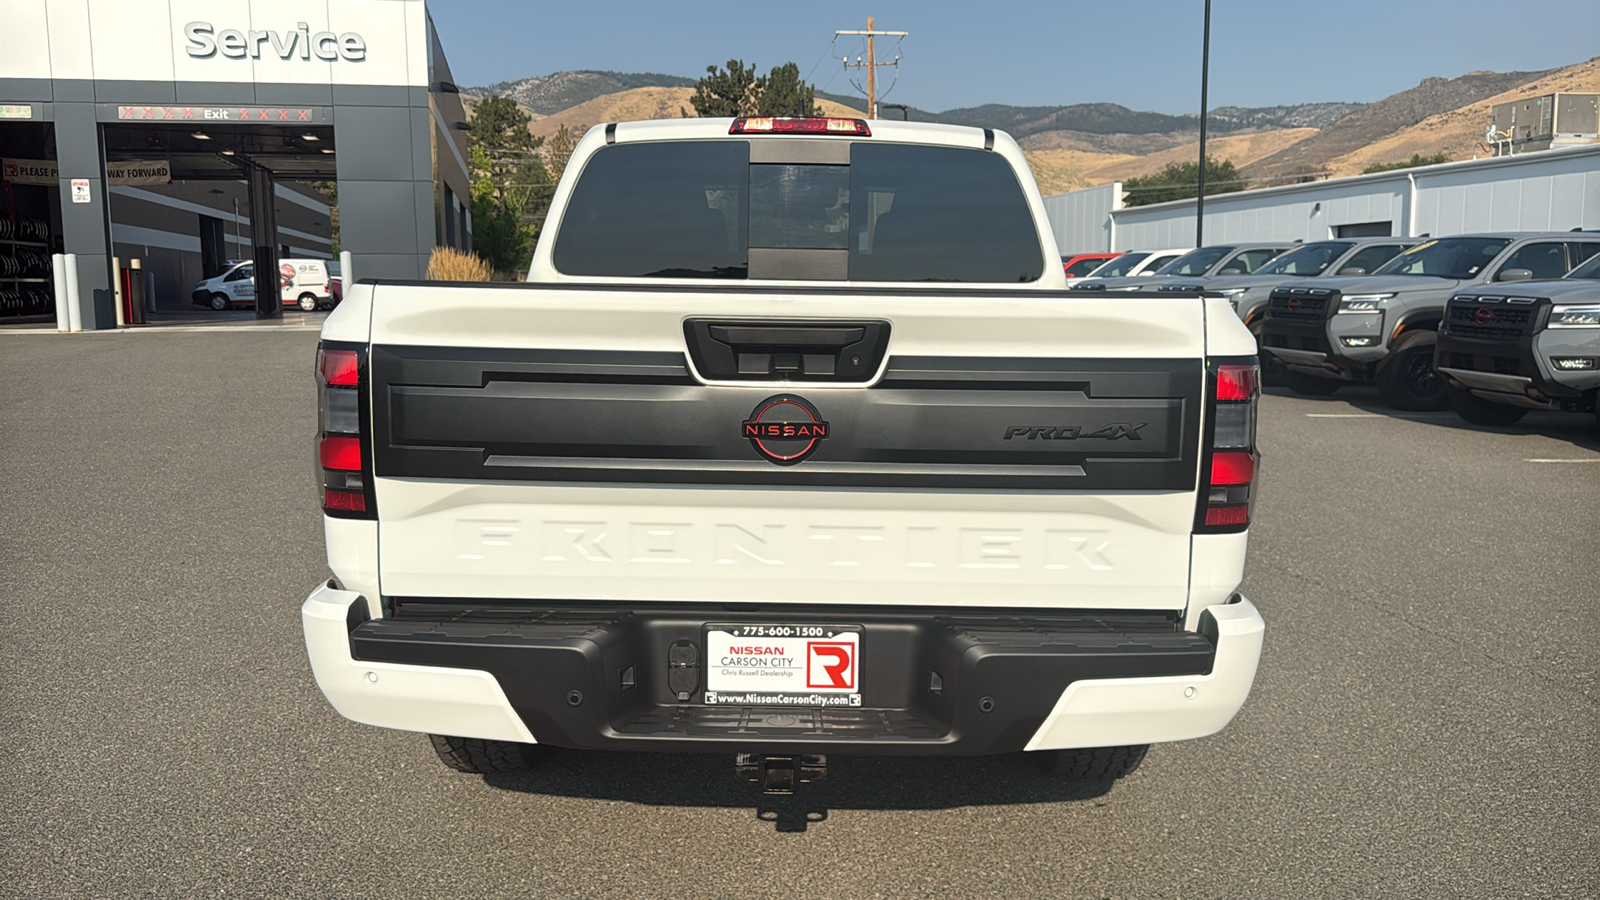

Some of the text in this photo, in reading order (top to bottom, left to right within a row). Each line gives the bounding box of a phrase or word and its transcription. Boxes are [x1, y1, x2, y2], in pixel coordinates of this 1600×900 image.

[184, 21, 366, 62] Service
[204, 109, 229, 119] Exit
[20, 166, 49, 177] PLEASE
[107, 169, 125, 178] WAY
[127, 168, 168, 178] FORWARD
[745, 424, 826, 436] NISSAN
[456, 518, 1116, 572] FRONTIER
[743, 626, 824, 637] 775-600-1500
[729, 646, 785, 656] NISSAN
[720, 656, 794, 667] CARSON CITY
[721, 668, 794, 678] Chris Russell Dealership
[718, 693, 849, 707] www.NissanCarsonCity.com
